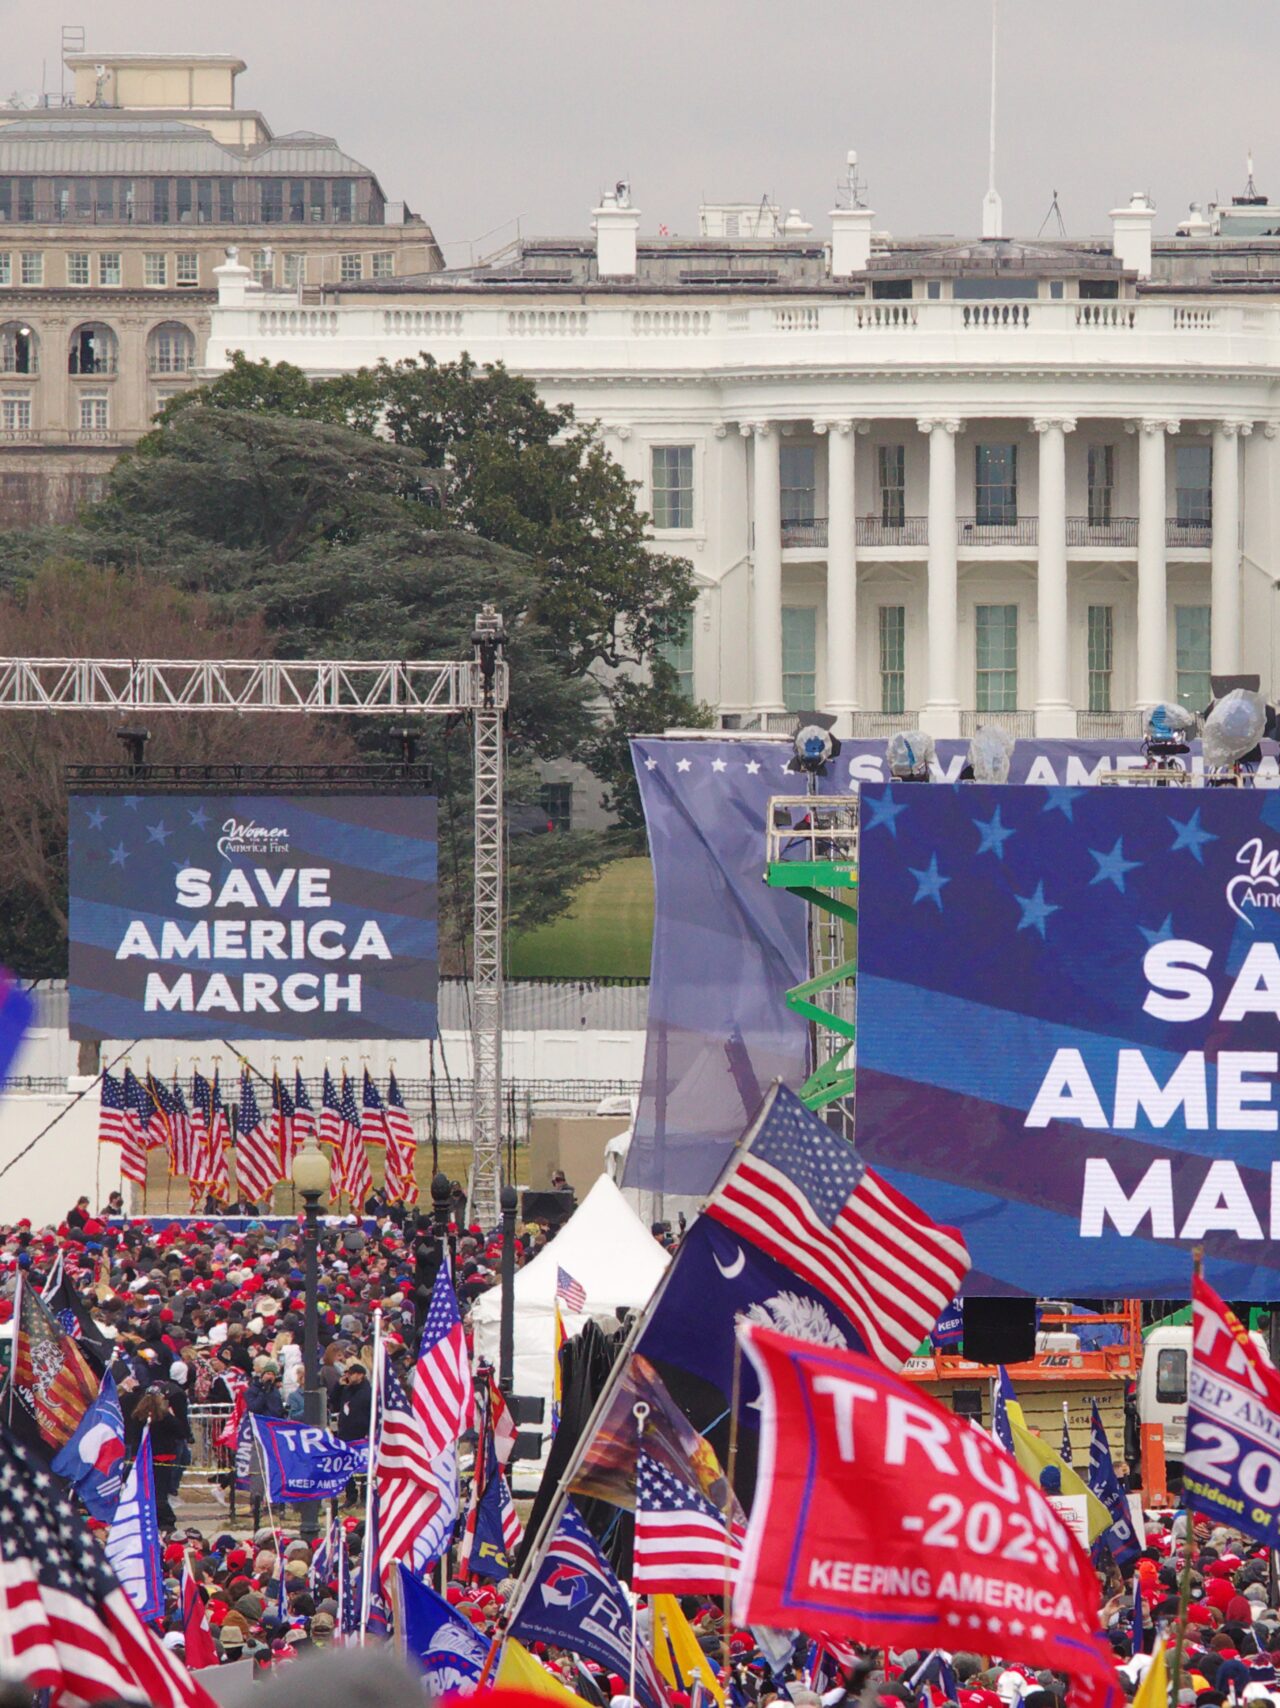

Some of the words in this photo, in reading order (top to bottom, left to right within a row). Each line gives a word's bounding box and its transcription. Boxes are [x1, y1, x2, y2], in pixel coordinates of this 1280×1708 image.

[222, 818, 290, 838] Women
[225, 842, 267, 853] America
[270, 842, 289, 853] First
[176, 868, 331, 908] SAVE
[115, 920, 393, 960] AMERICA
[144, 972, 362, 1013] MARCH
[288, 1478, 315, 1488] KEEP
[809, 1557, 932, 1598] KEEPING
[936, 1571, 1077, 1624] AMERICA
